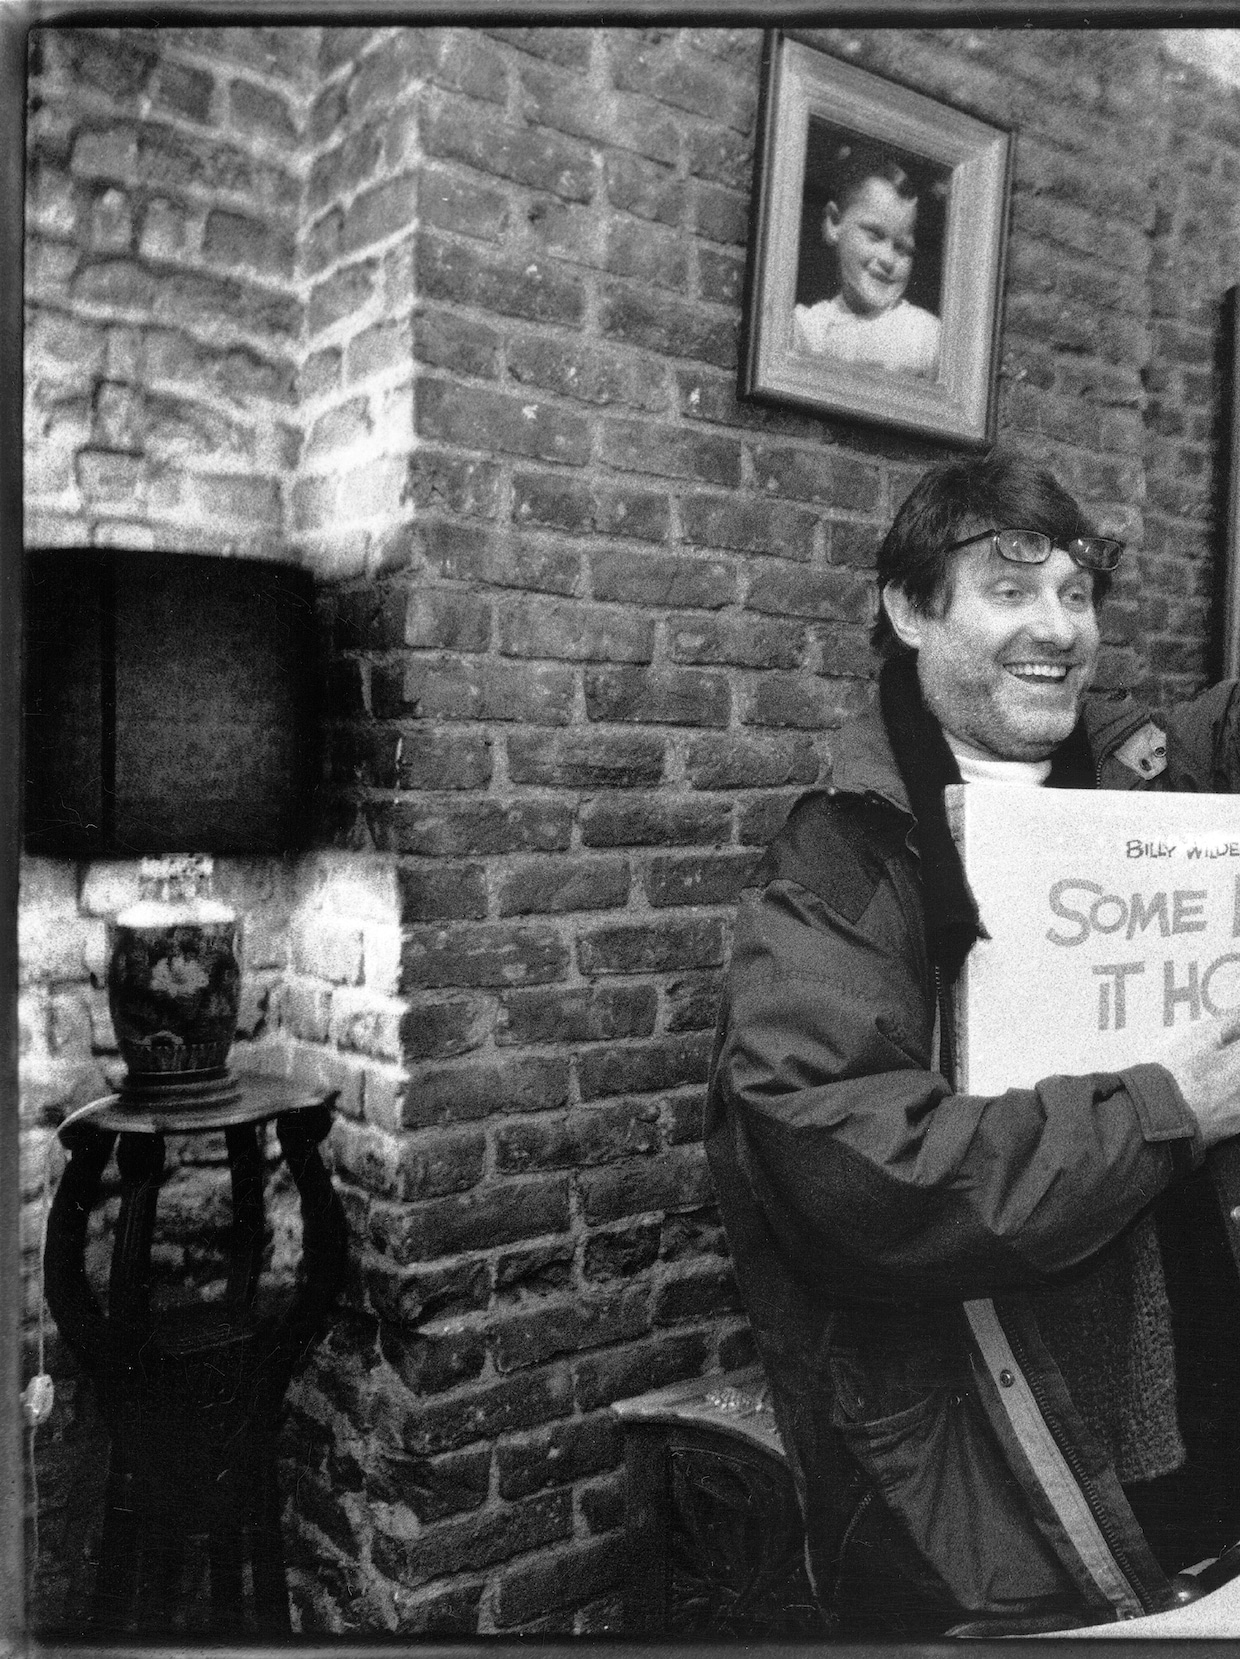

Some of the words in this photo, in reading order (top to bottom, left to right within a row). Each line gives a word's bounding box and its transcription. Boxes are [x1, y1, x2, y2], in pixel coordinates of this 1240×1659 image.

[1126, 839, 1177, 859] BILLY
[1045, 877, 1208, 947] SOME
[1092, 960, 1146, 1031] IT
